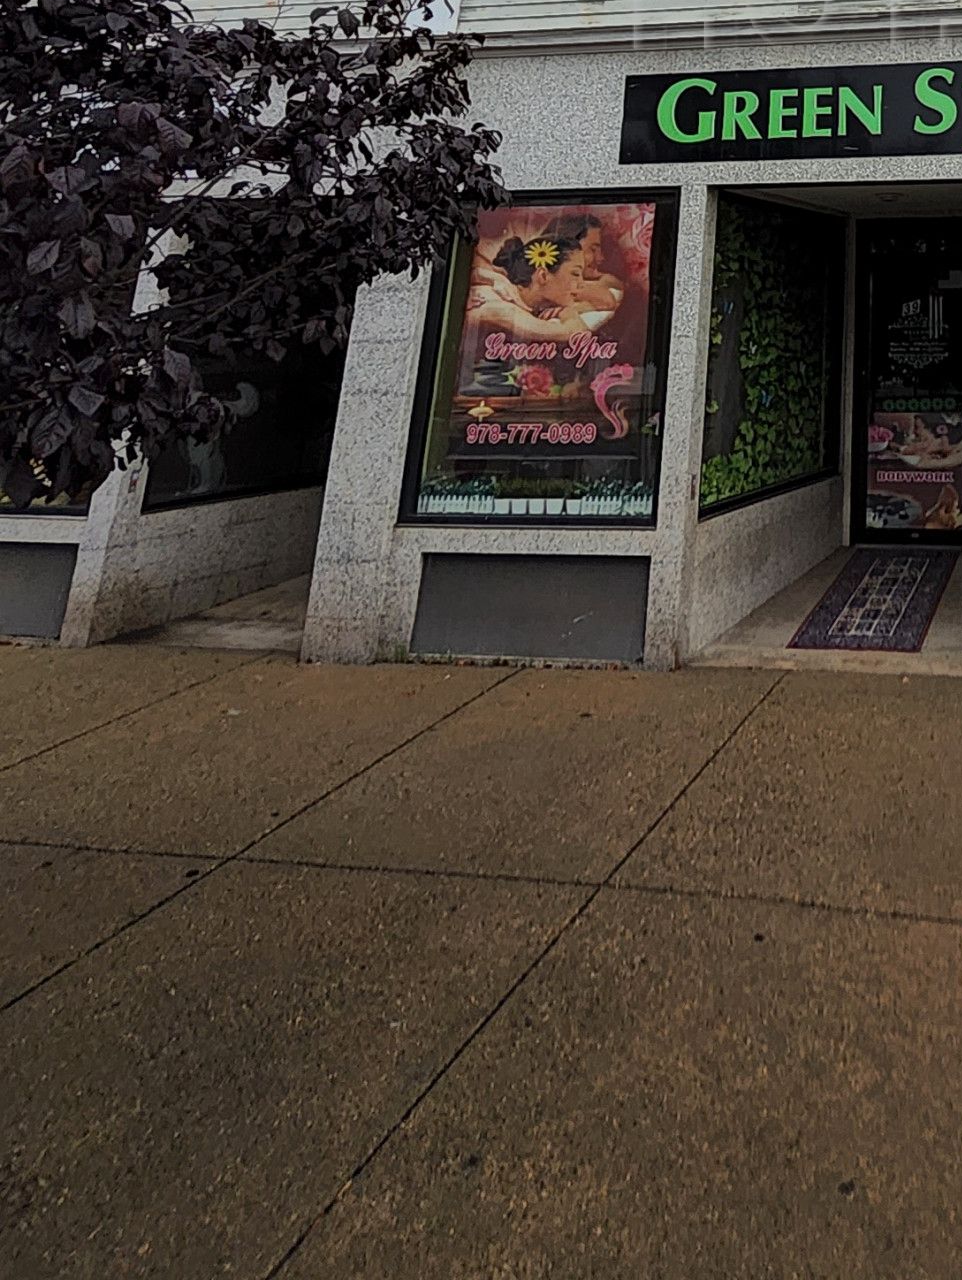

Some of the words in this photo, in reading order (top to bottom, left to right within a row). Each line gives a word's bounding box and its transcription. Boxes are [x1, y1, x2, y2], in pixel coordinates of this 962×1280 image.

[656, 77, 883, 143] GREEN
[485, 332, 557, 360] Green
[563, 331, 618, 368] Spa
[466, 422, 597, 445] 978-777-0989
[877, 470, 955, 483] BODYWORK
